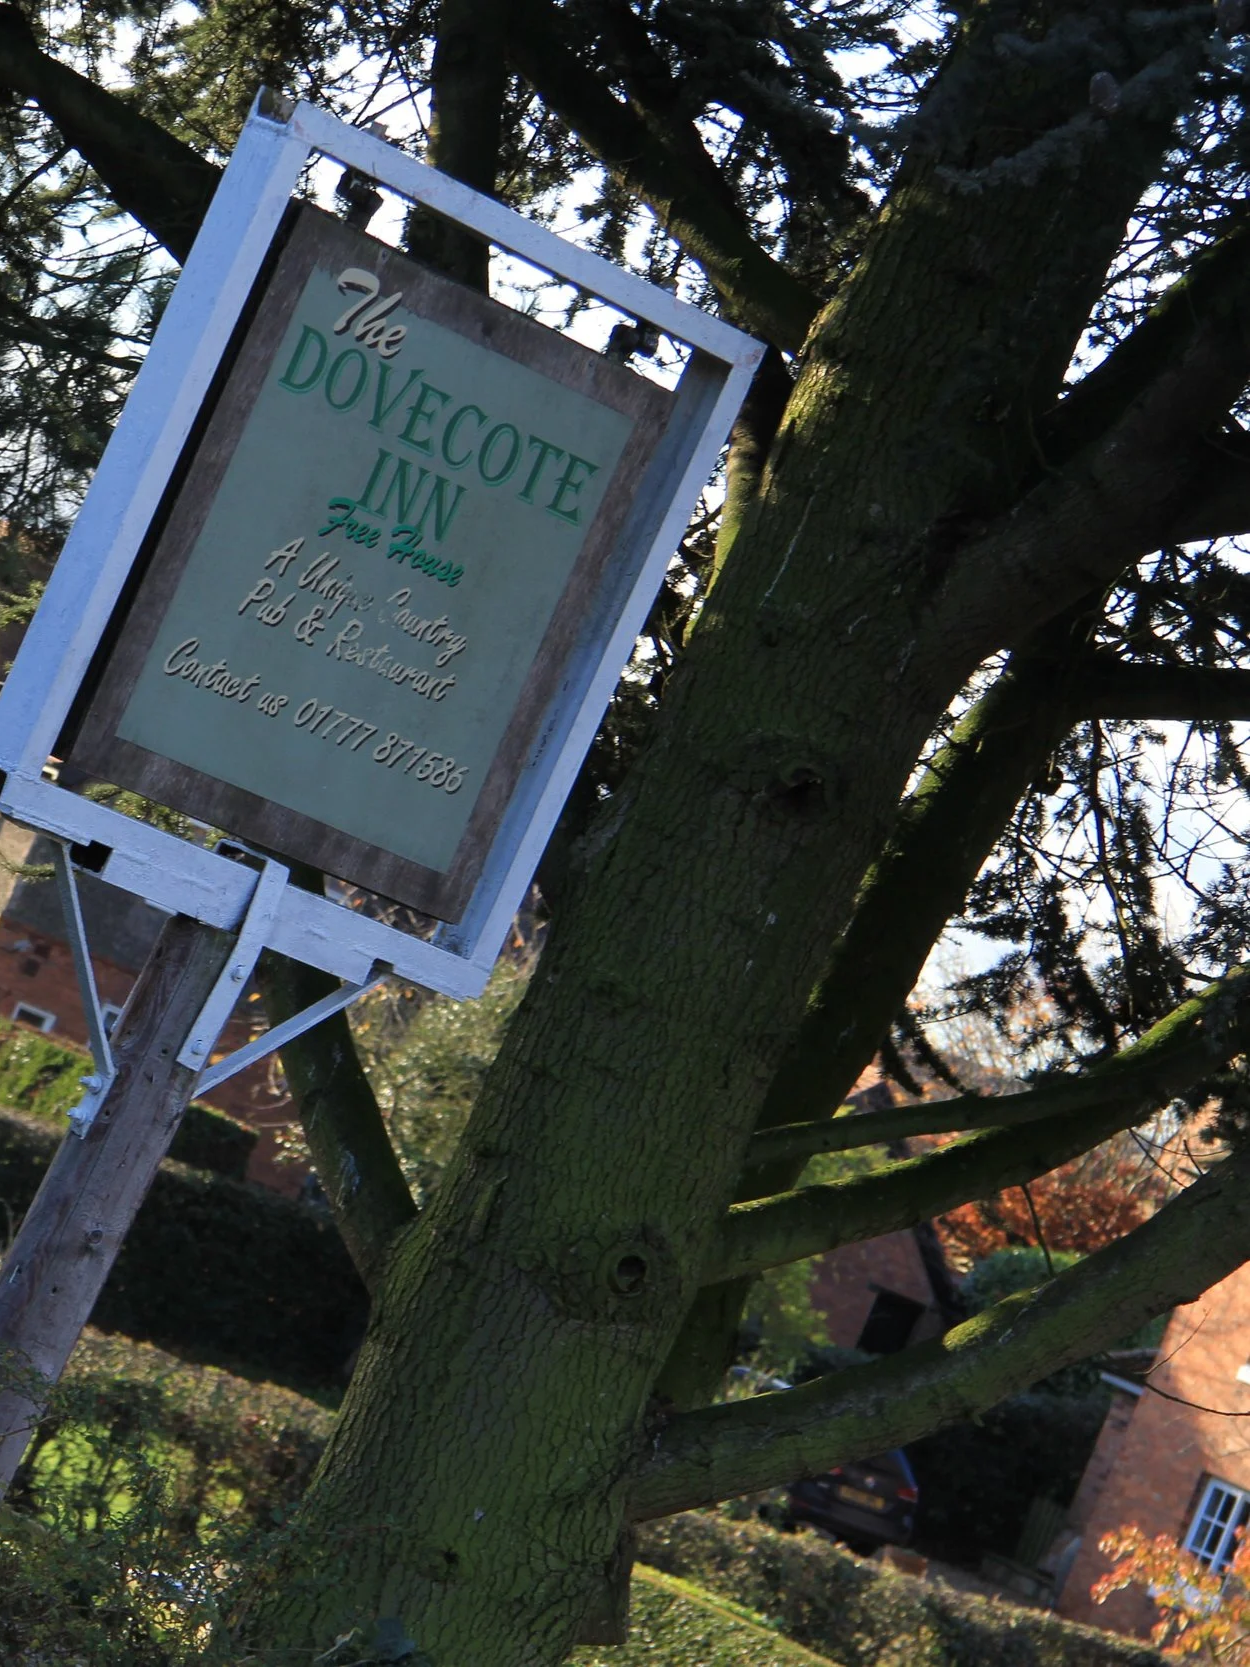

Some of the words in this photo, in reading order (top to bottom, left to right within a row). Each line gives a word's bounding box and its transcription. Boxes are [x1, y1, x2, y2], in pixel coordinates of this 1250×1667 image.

[334, 268, 408, 359] The
[278, 323, 601, 527] DOVECOTE
[318, 497, 382, 549] Free
[387, 525, 465, 587] House
[355, 448, 468, 542] INN
[265, 537, 305, 576] A
[238, 577, 296, 627] Pub
[294, 605, 325, 645] &
[326, 618, 456, 702] Restaurant
[163, 637, 262, 702] Contact
[257, 694, 289, 716] us
[294, 698, 378, 752] 01777
[373, 732, 469, 794] 871586
